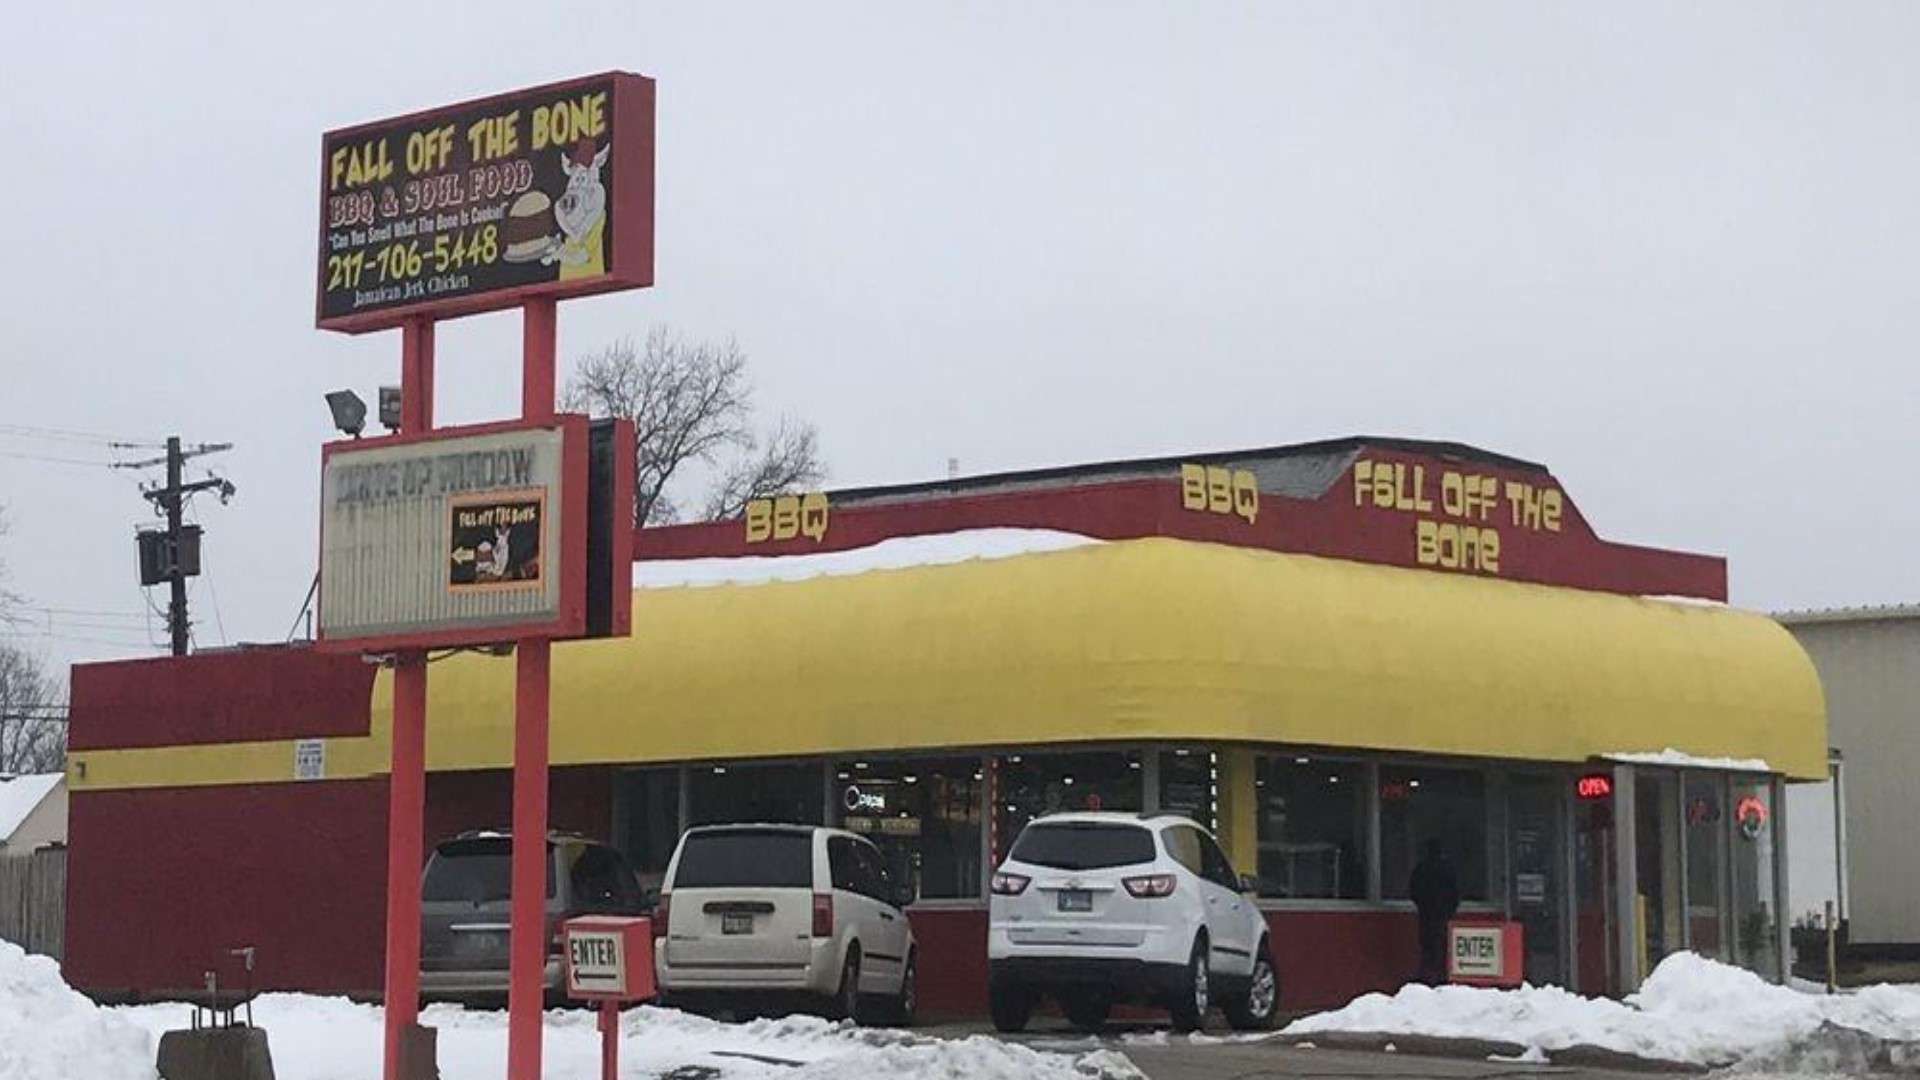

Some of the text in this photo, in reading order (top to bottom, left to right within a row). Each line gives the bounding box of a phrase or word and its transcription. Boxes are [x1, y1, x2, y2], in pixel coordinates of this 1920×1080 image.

[332, 93, 606, 189] FALL OFF THE BONE
[330, 162, 532, 227] BBQ & SOUL FOOD
[419, 217, 434, 233] The
[328, 226, 497, 290] 217-706-5448
[353, 274, 469, 308] Jamaican Jerk Chicken
[402, 456, 432, 496] UP
[1182, 463, 1260, 525] BBQ
[1441, 472, 1498, 521] OFF
[745, 493, 829, 544] BBQ
[1579, 778, 1610, 796] OPEN
[569, 938, 616, 966] ENTER
[1456, 936, 1495, 959] ENTER
